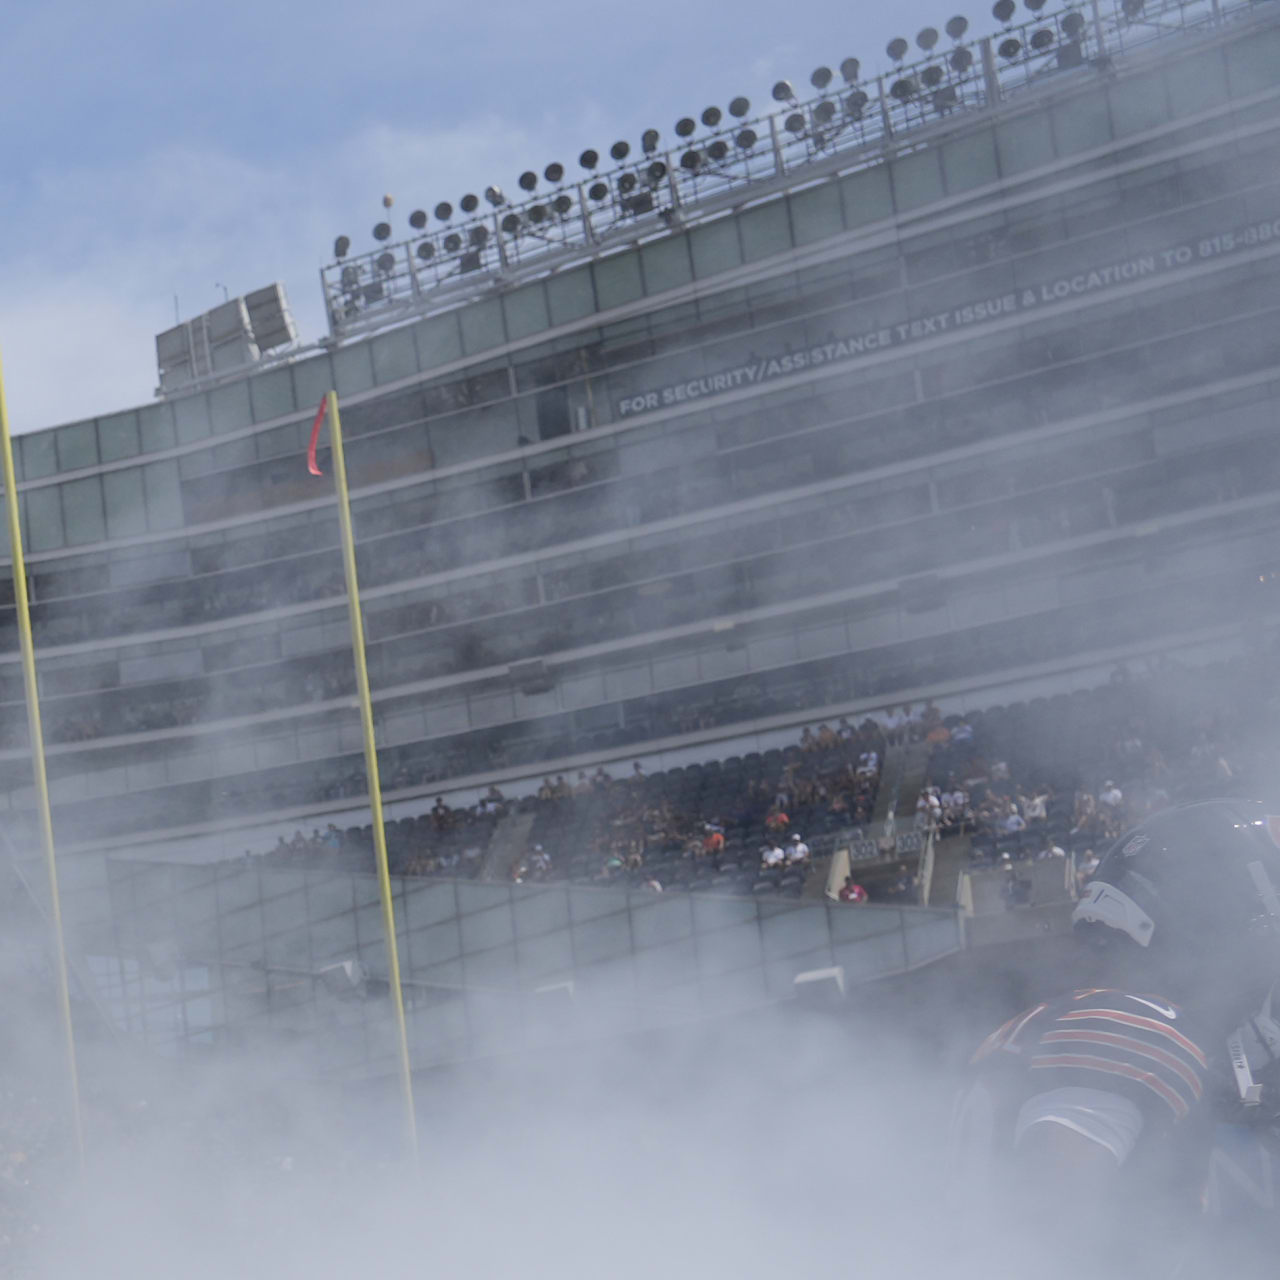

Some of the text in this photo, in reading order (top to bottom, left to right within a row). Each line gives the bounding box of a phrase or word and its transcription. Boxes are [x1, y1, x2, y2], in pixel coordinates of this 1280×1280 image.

[619, 394, 658, 415] FOR
[896, 315, 951, 341] TEXT
[954, 294, 1017, 325] ISSUE
[1041, 256, 1156, 301] LOCATION
[1160, 247, 1192, 269] TO
